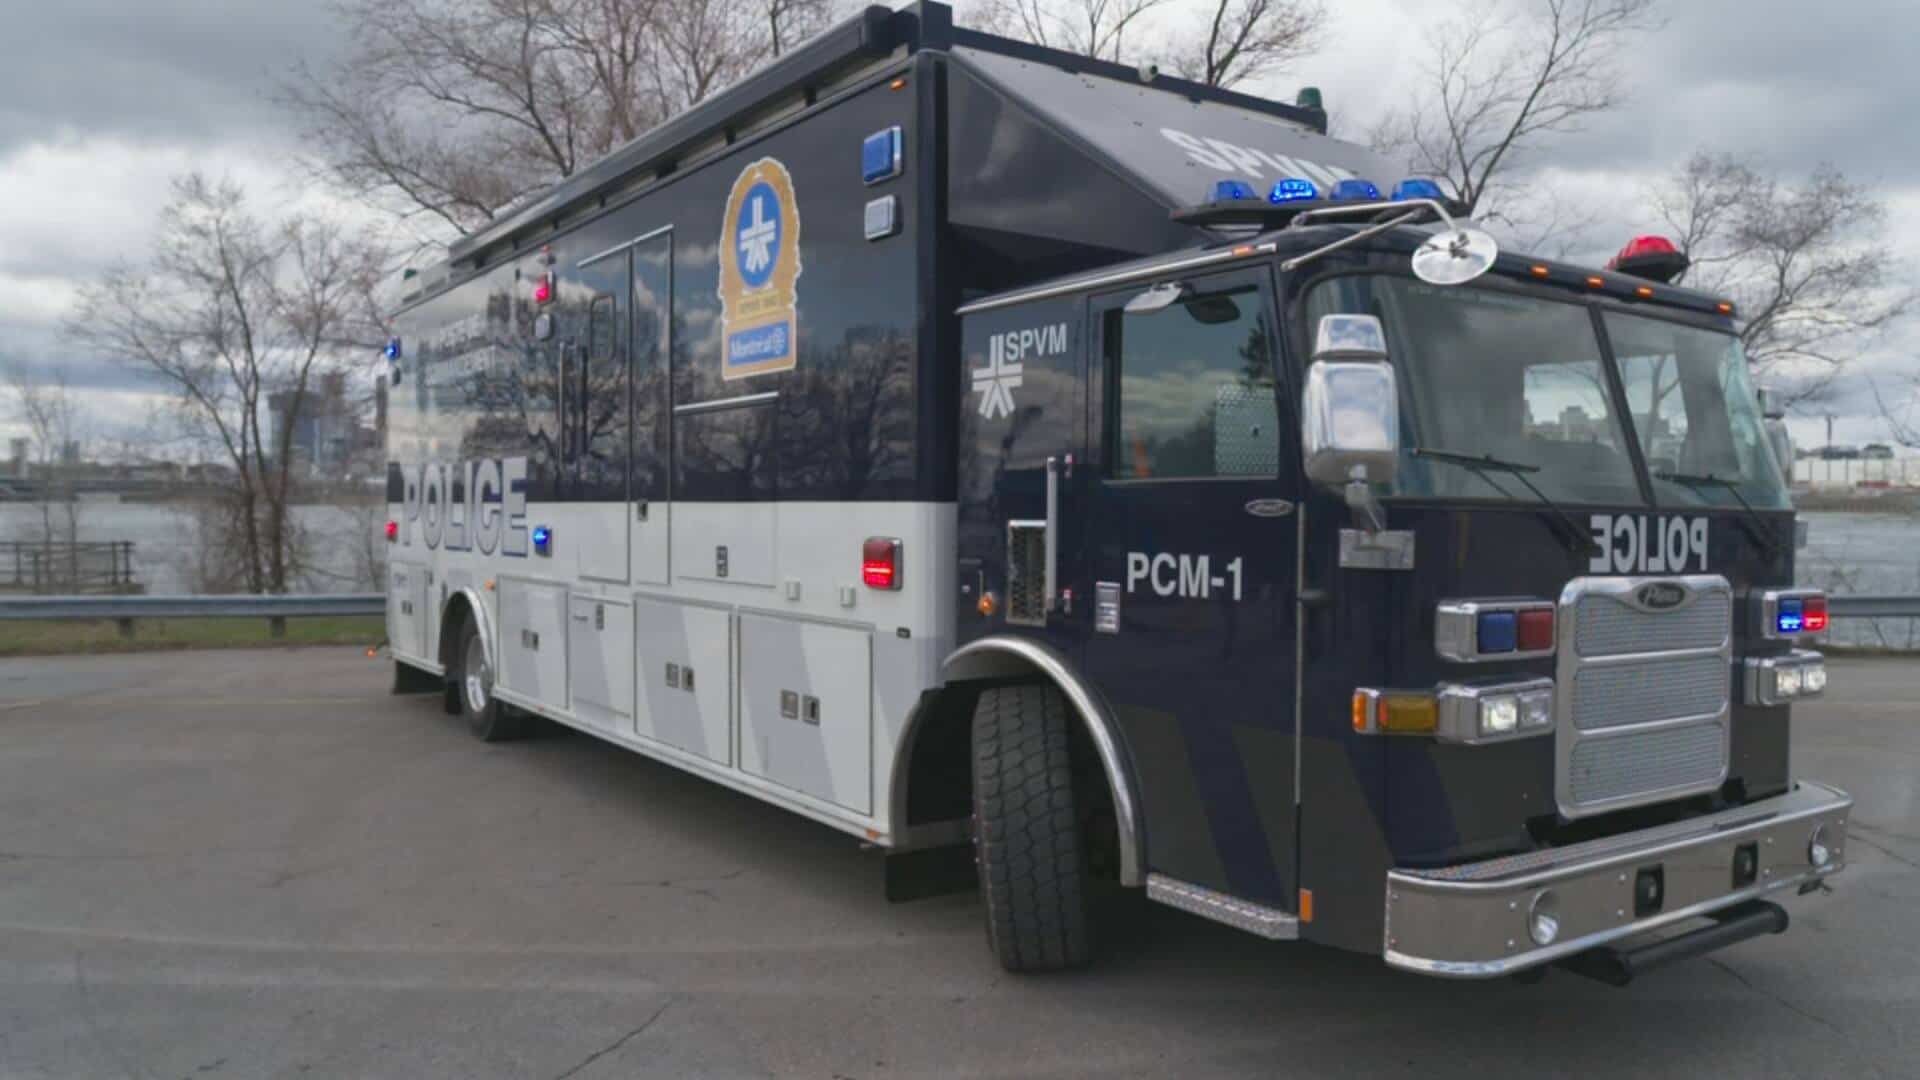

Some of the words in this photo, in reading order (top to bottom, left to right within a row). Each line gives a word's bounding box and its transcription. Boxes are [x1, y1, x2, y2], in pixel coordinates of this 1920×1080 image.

[1005, 323, 1068, 361] SPVM
[402, 456, 529, 559] POLICE
[1127, 552, 1243, 601] PCM-1
